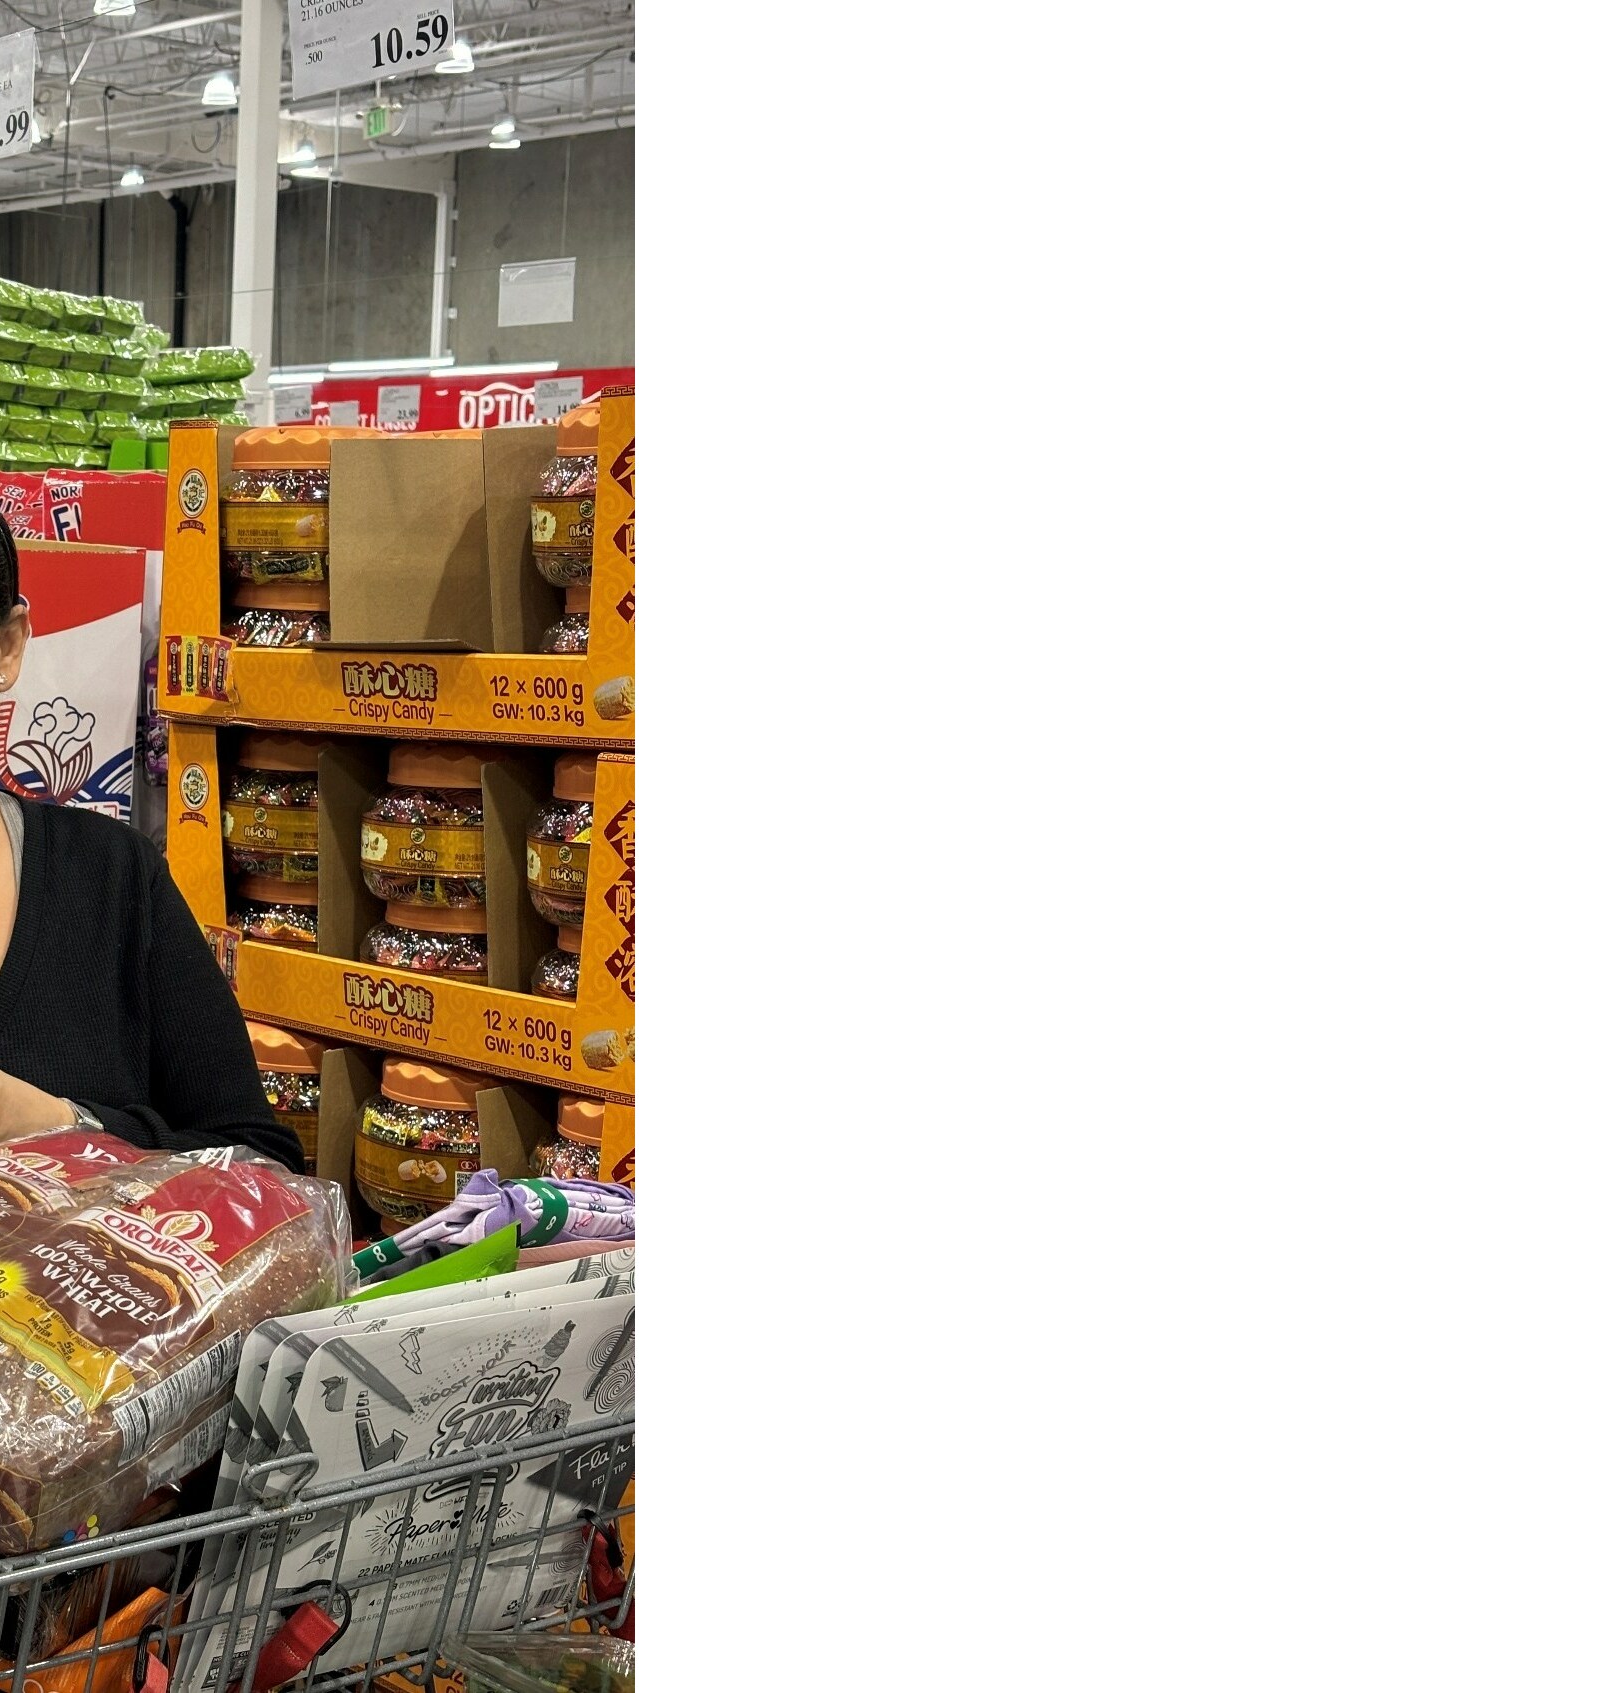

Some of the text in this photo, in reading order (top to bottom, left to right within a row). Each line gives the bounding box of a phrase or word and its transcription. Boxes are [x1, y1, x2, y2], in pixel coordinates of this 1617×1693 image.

[301, 0, 363, 22] 21.16 OUNCES
[305, 51, 323, 65] .500
[371, 14, 448, 68] 10.59
[3, 80, 13, 90] EA
[3, 485, 25, 500] SEA
[343, 662, 437, 700] 酥心糖
[490, 676, 509, 697] 12
[533, 677, 567, 699] 600
[572, 684, 583, 704] g
[349, 699, 433, 724] Crispy Candy
[493, 704, 585, 726] GW: 10.3 kg
[343, 973, 434, 1023] 酥心糖
[349, 1008, 431, 1046] Crispy Candy
[483, 1009, 501, 1031] 12
[524, 1017, 557, 1042] 600
[561, 1028, 572, 1050] g
[485, 1036, 572, 1070] GW: 10.3 kg
[103, 1214, 207, 1278] OROWEAT
[29, 1243, 160, 1326] 100% WHOLE
[41, 1263, 118, 1319] WHEAT
[57, 1239, 163, 1307] Whole Grains
[419, 1340, 517, 1406] BOOST YOUR
[472, 1368, 553, 1406] writing
[613, 1462, 627, 1475] TIP
[358, 1568, 369, 1578] 22
